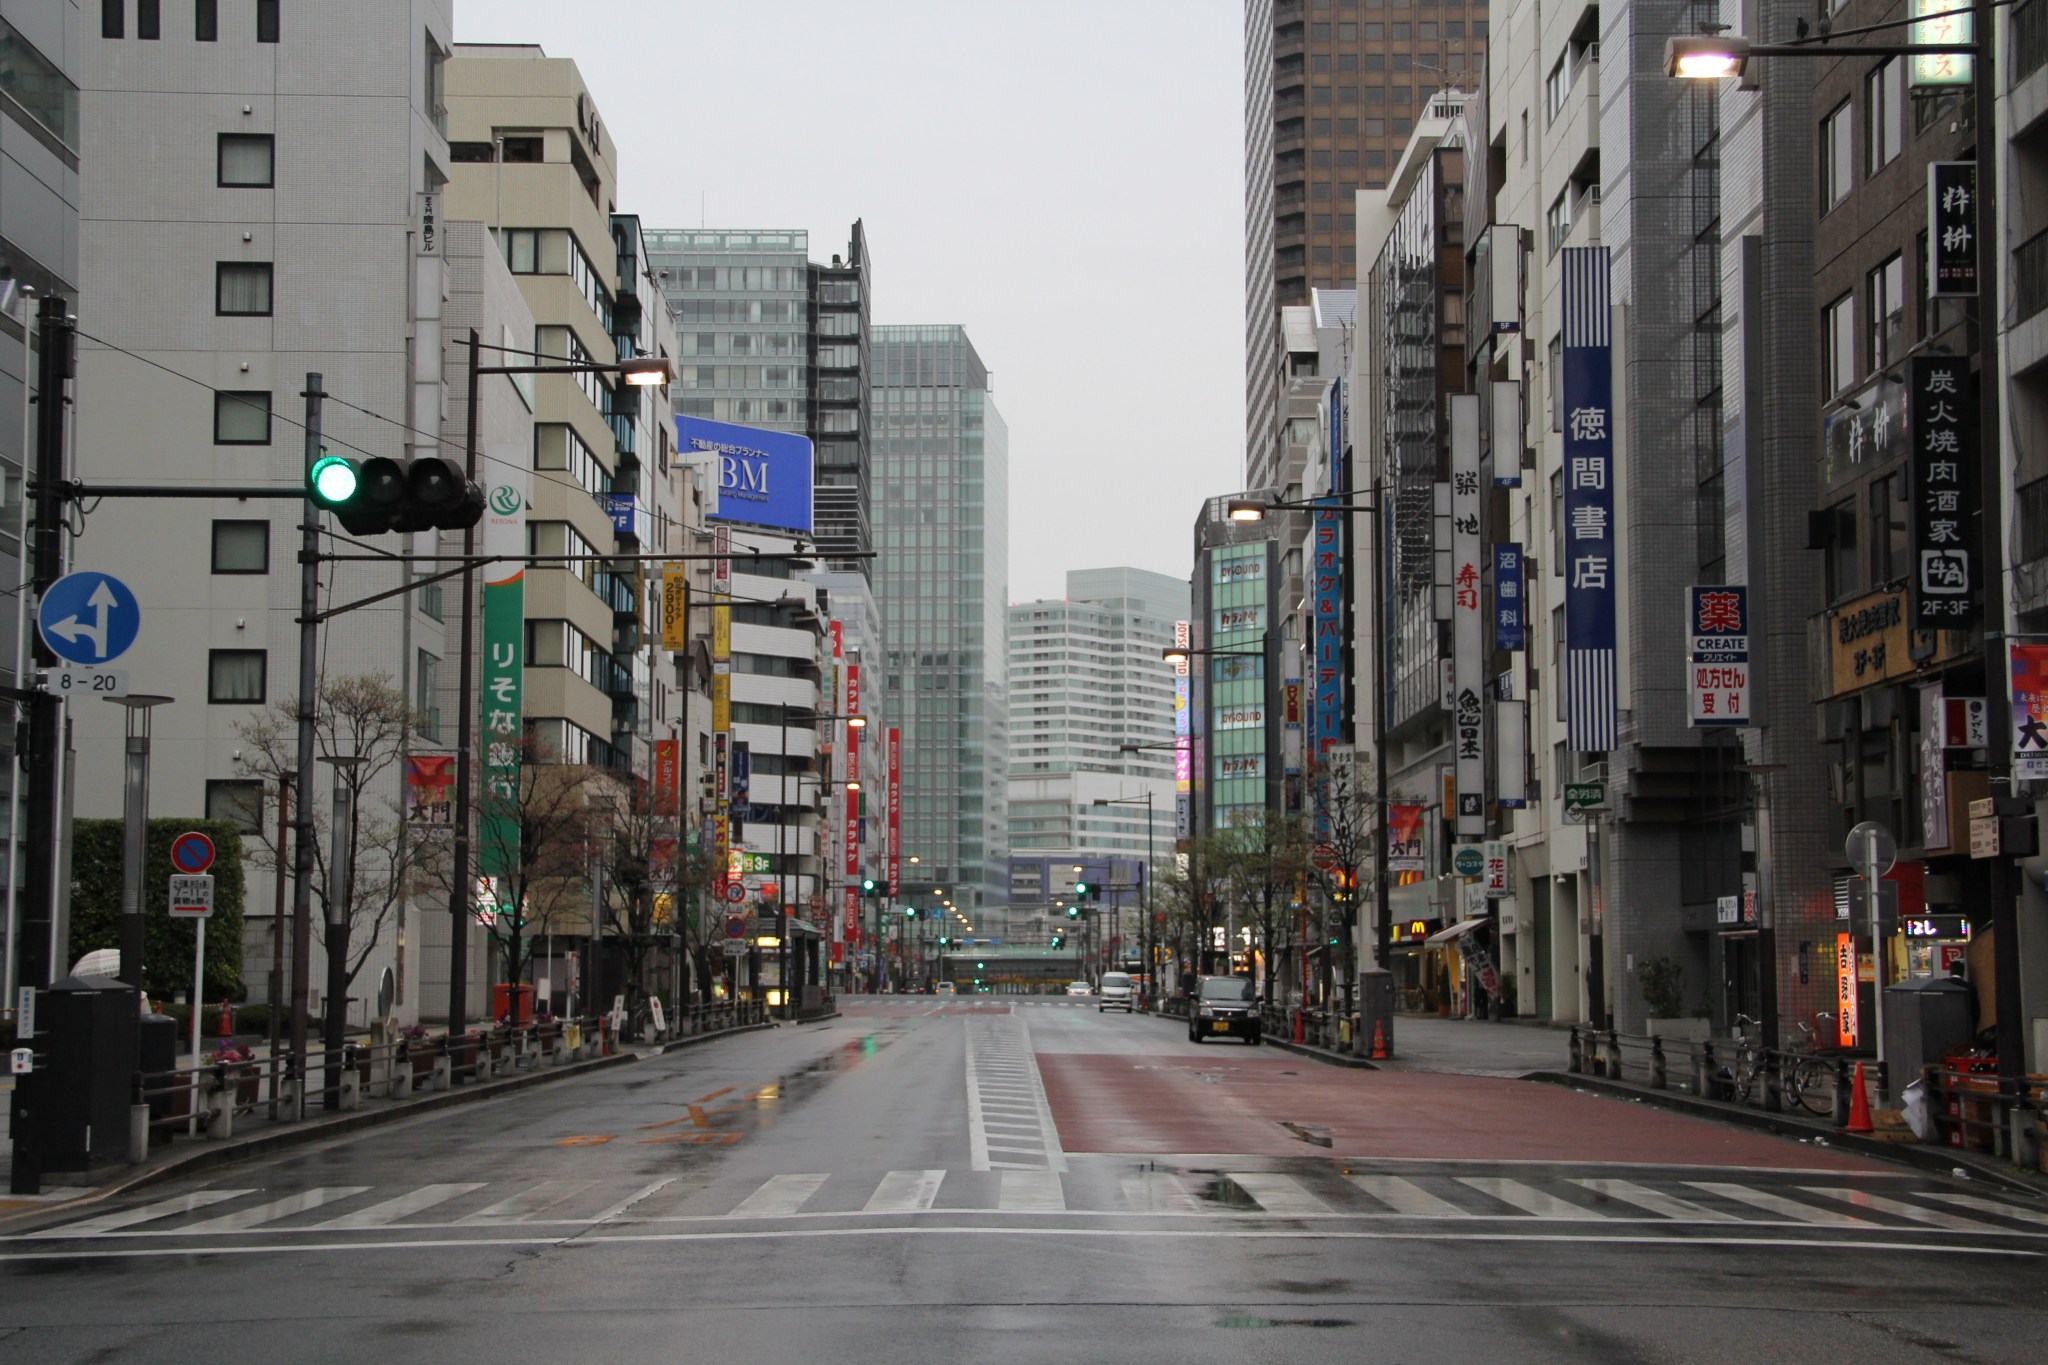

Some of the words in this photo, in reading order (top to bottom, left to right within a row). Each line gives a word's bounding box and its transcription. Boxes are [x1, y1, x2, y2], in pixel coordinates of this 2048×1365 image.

[1925, 369, 1960, 543] 炭火焼肉酒家
[1570, 407, 1607, 589] 徳間書店
[491, 517, 518, 525] RESONA
[1500, 552, 1518, 627] 沼歯科
[1699, 592, 1741, 632] 薬
[1697, 638, 1745, 649] CREATE
[1703, 654, 1737, 662] クリエイト
[1697, 668, 1745, 689] 処方せん
[1567, 788, 1602, 800] 全労済
[1391, 838, 1421, 856] 大門
